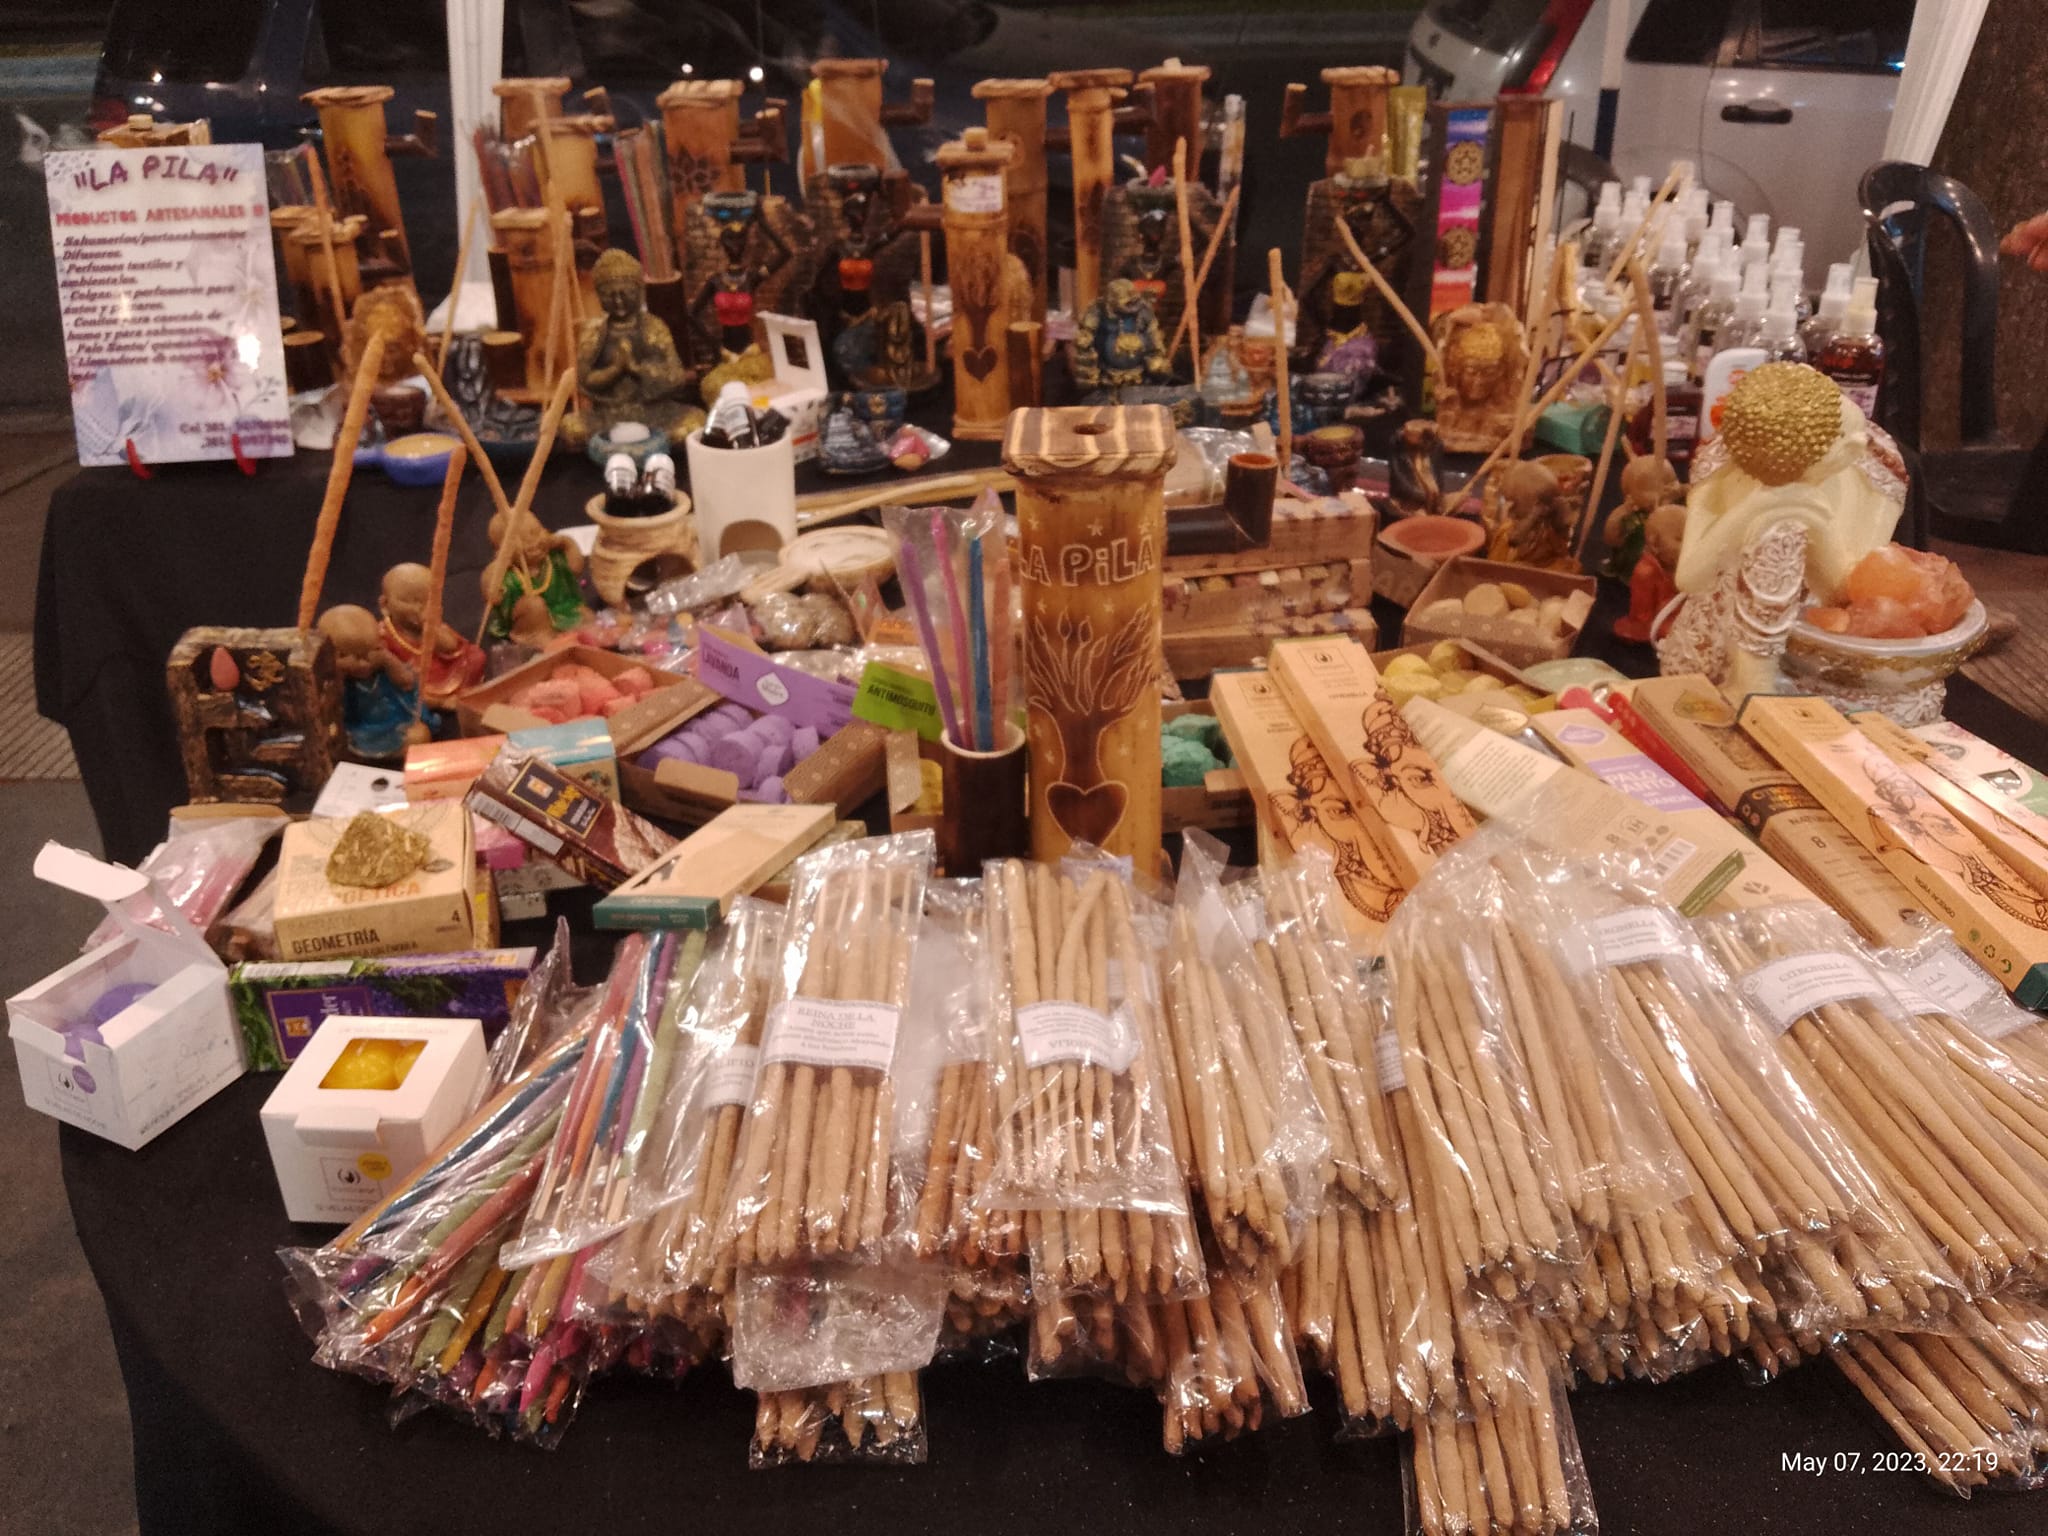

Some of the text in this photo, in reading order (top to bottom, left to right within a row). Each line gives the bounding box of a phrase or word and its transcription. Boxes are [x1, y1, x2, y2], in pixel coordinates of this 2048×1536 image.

[56, 209, 137, 227] PRODUCTOS
[145, 205, 246, 223] ARTESANALES
[451, 909, 461, 923] 4
[291, 927, 381, 955] GEOMETRÍA
